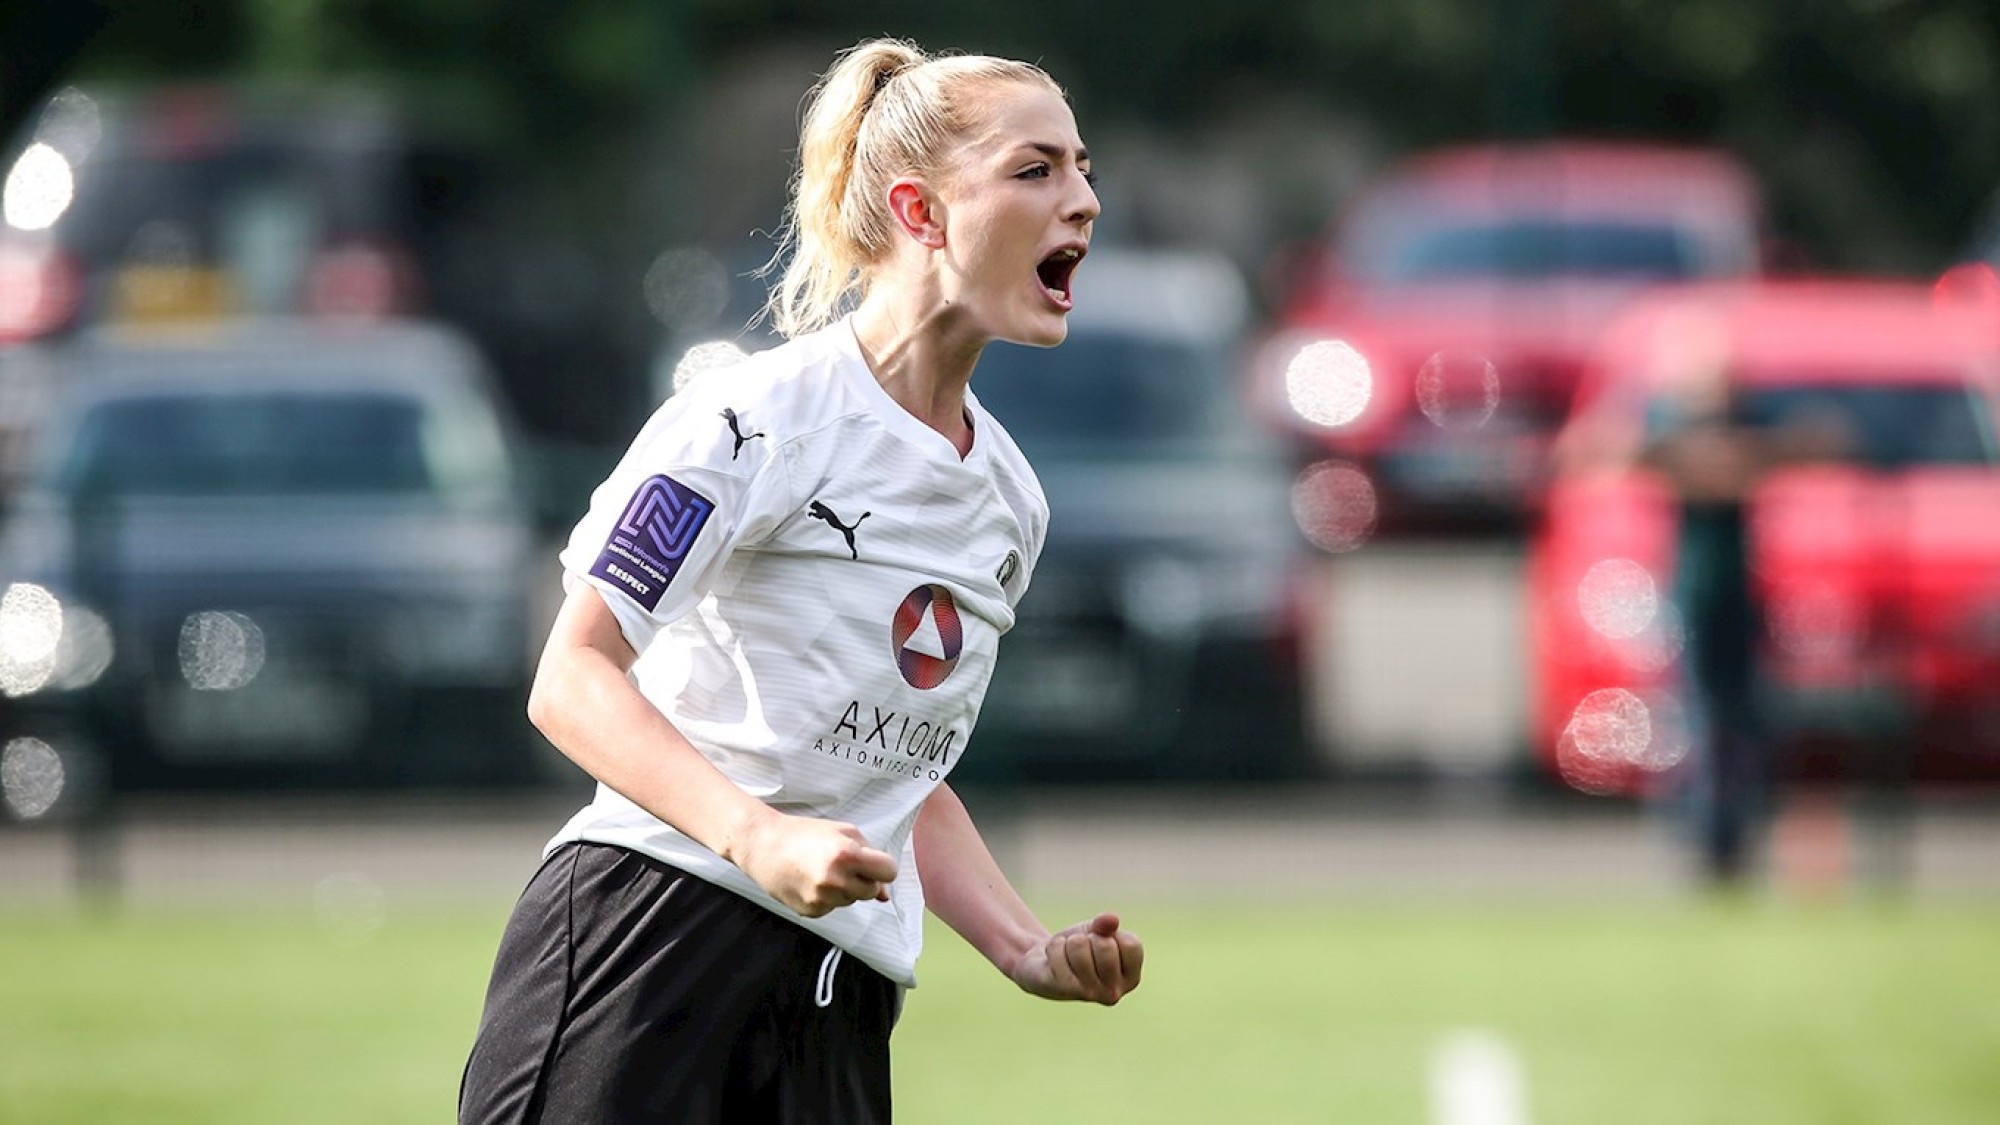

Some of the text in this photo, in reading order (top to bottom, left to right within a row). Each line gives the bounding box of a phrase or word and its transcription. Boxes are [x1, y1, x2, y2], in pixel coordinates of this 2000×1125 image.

[606, 562, 650, 595] RESPECT
[608, 543, 667, 584] National League
[833, 700, 956, 765] AXIOM
